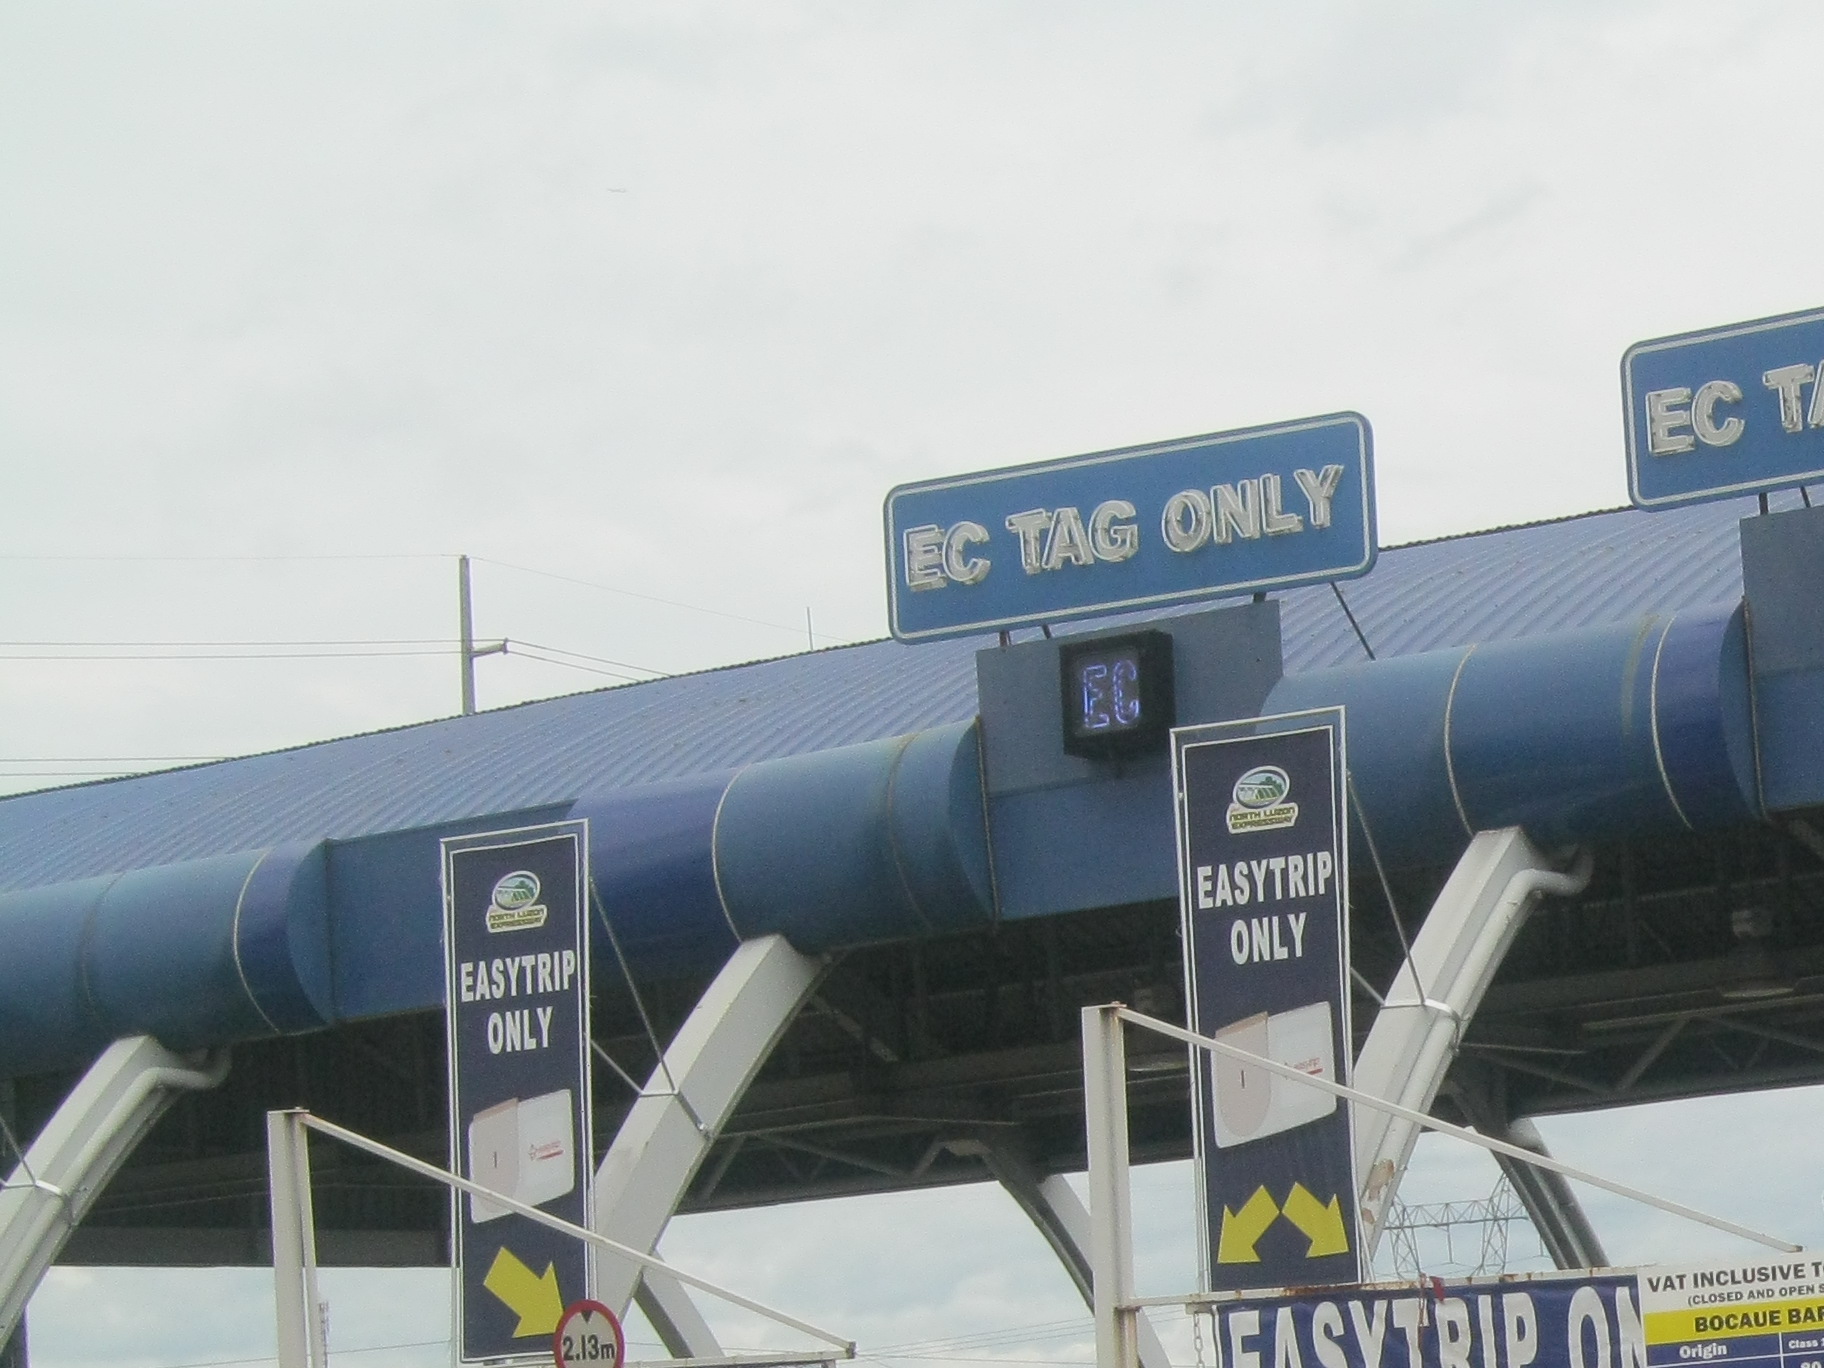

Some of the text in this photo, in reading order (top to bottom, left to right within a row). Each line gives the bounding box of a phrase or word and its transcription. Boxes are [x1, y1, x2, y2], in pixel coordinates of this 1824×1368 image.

[1644, 379, 1745, 460] EC
[902, 462, 1347, 592] EC TAG ONLY
[1082, 659, 1140, 729] EC
[1198, 851, 1332, 909] EASYTRIP
[1230, 911, 1306, 966] ONLY
[461, 950, 577, 1004] EASYTRIP
[488, 1005, 553, 1054] ONLY
[1648, 1274, 1686, 1292] VAT
[1694, 1264, 1805, 1288] INCLUSIVE
[1688, 1290, 1743, 1307] (CLOSED
[1748, 1288, 1774, 1300] AND
[1779, 1285, 1814, 1298] OPEN
[1695, 1310, 1781, 1332] BOCAUE
[563, 1334, 615, 1361] 2.13m
[1679, 1343, 1727, 1361] Origin
[1789, 1338, 1817, 1349] Class
